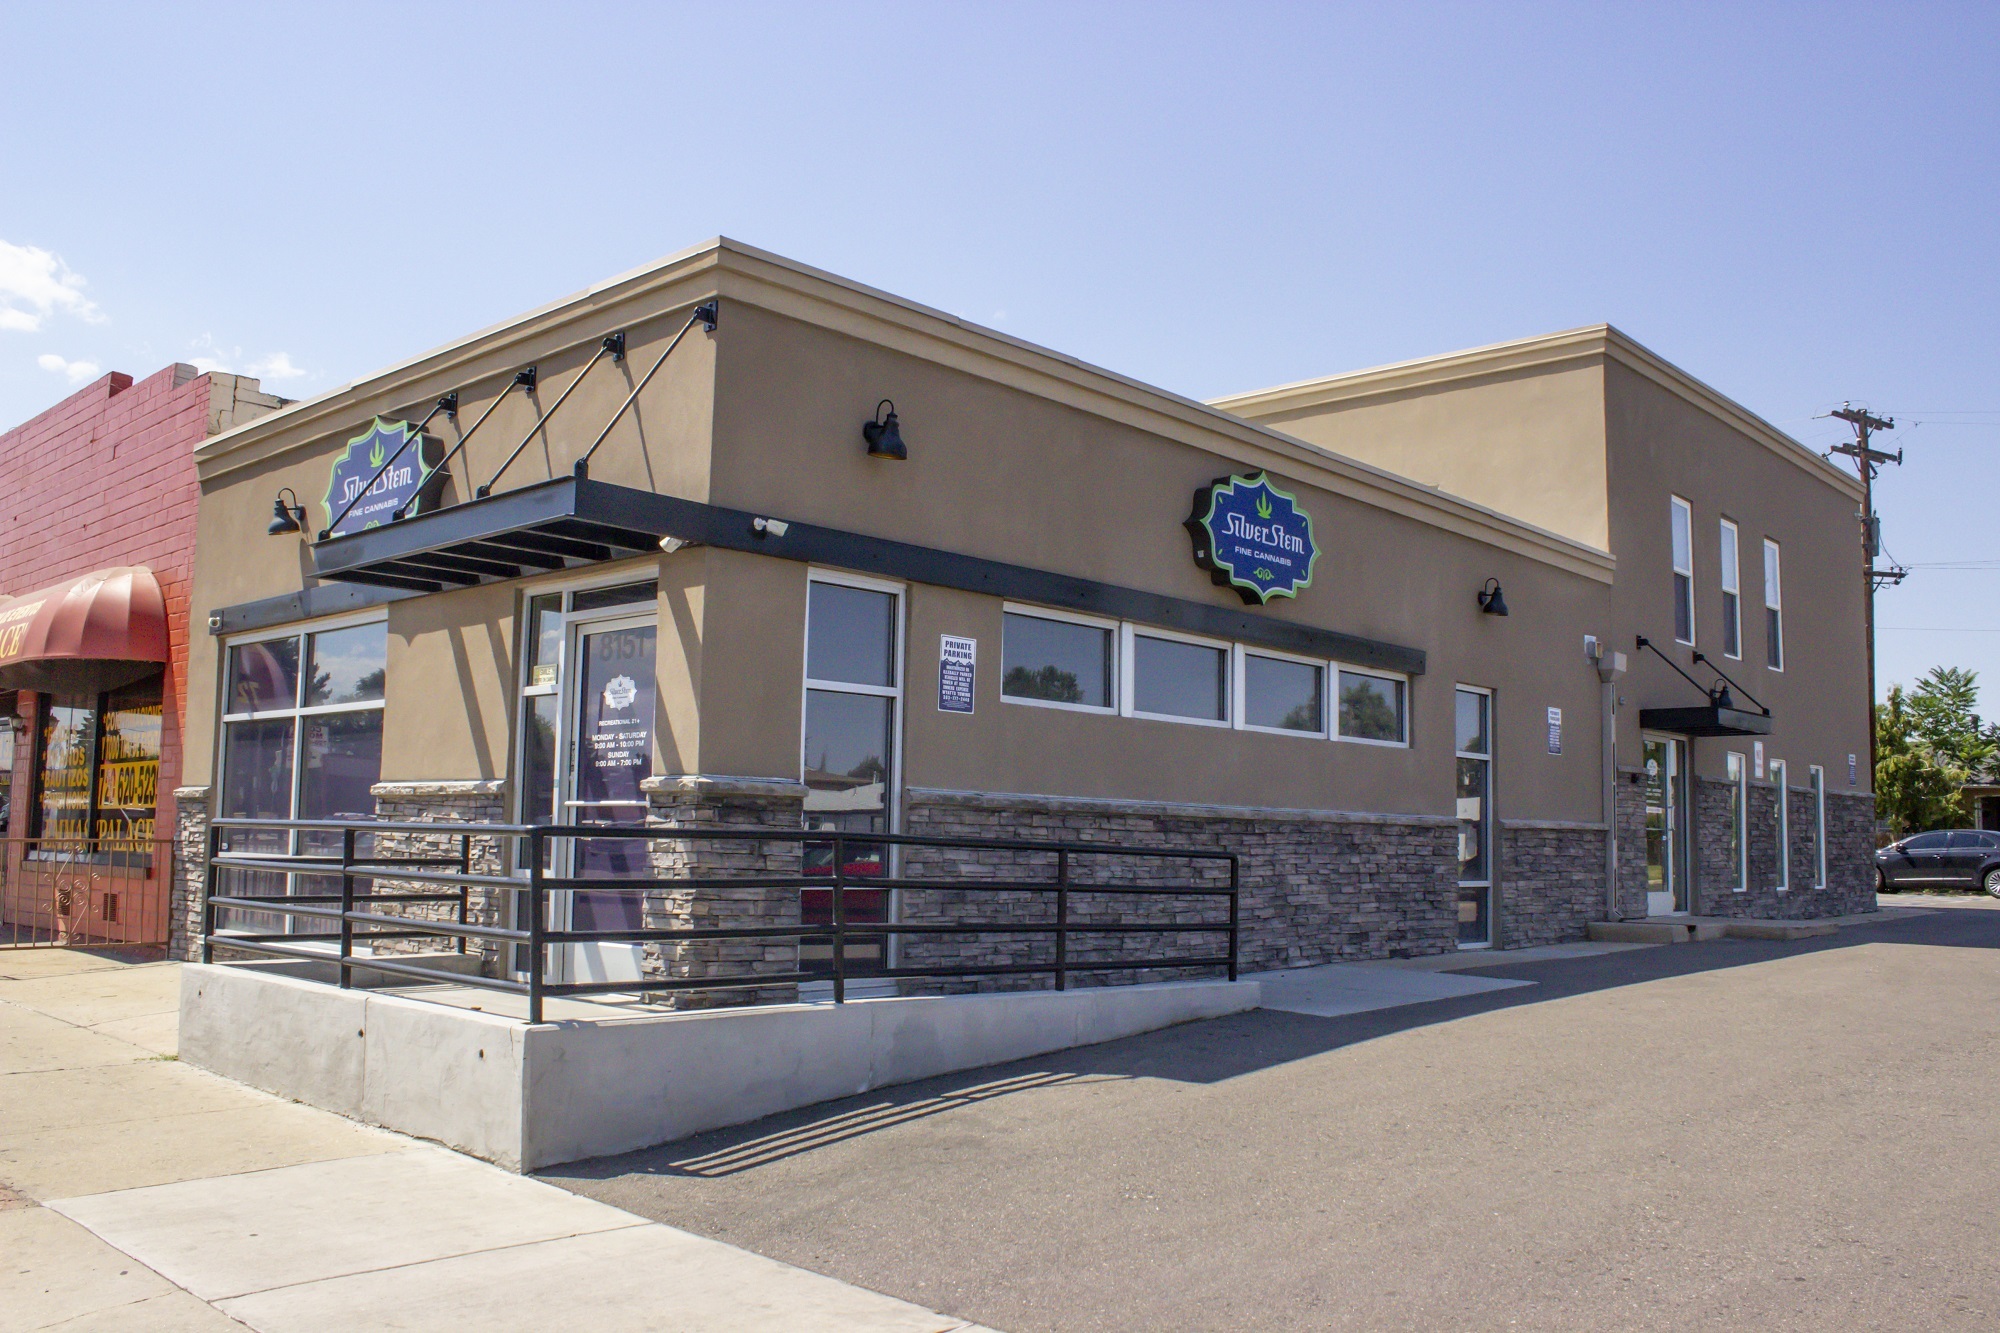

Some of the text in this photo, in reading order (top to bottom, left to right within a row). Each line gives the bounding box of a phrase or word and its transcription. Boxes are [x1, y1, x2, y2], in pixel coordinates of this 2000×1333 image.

[348, 498, 398, 518] FINE CANNABIS
[1234, 546, 1292, 566] FINE CANNABIS
[601, 630, 645, 661] 8151
[945, 640, 972, 651] PRIVATE
[944, 649, 972, 660] PARKING
[619, 731, 647, 740] SATURDAY
